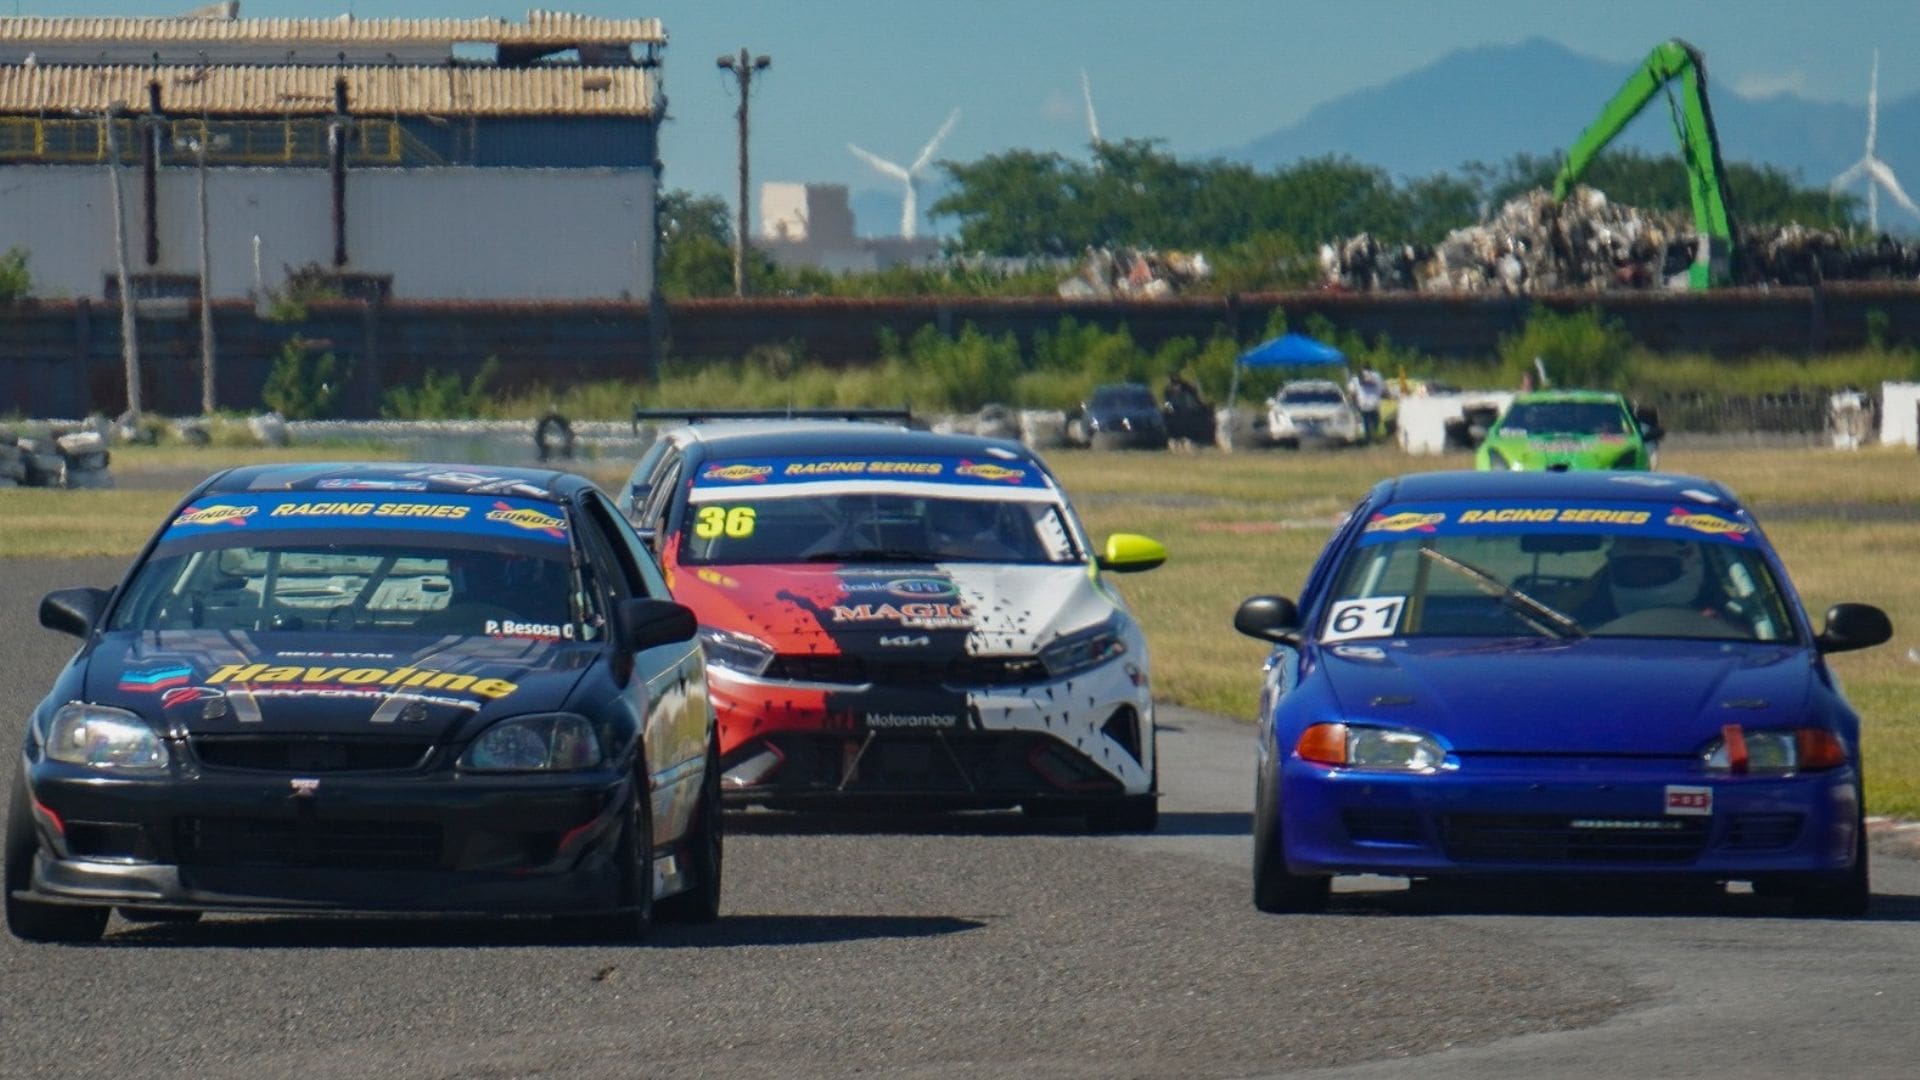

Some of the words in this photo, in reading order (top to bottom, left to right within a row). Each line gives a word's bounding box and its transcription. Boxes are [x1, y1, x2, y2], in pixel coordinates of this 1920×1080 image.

[784, 461, 866, 476] RACING
[867, 461, 943, 476] SERIES
[173, 505, 259, 526] SUNOCO
[270, 503, 375, 517] RACING
[373, 503, 471, 519] SERIES
[486, 508, 569, 530] SUNOCO
[695, 505, 757, 538] 36
[1457, 509, 1559, 524] RACING
[1557, 509, 1652, 525] SERIES
[485, 620, 500, 635] P.
[502, 620, 560, 637] Besosa
[1333, 602, 1400, 633] 61
[205, 663, 519, 699] Havoline
